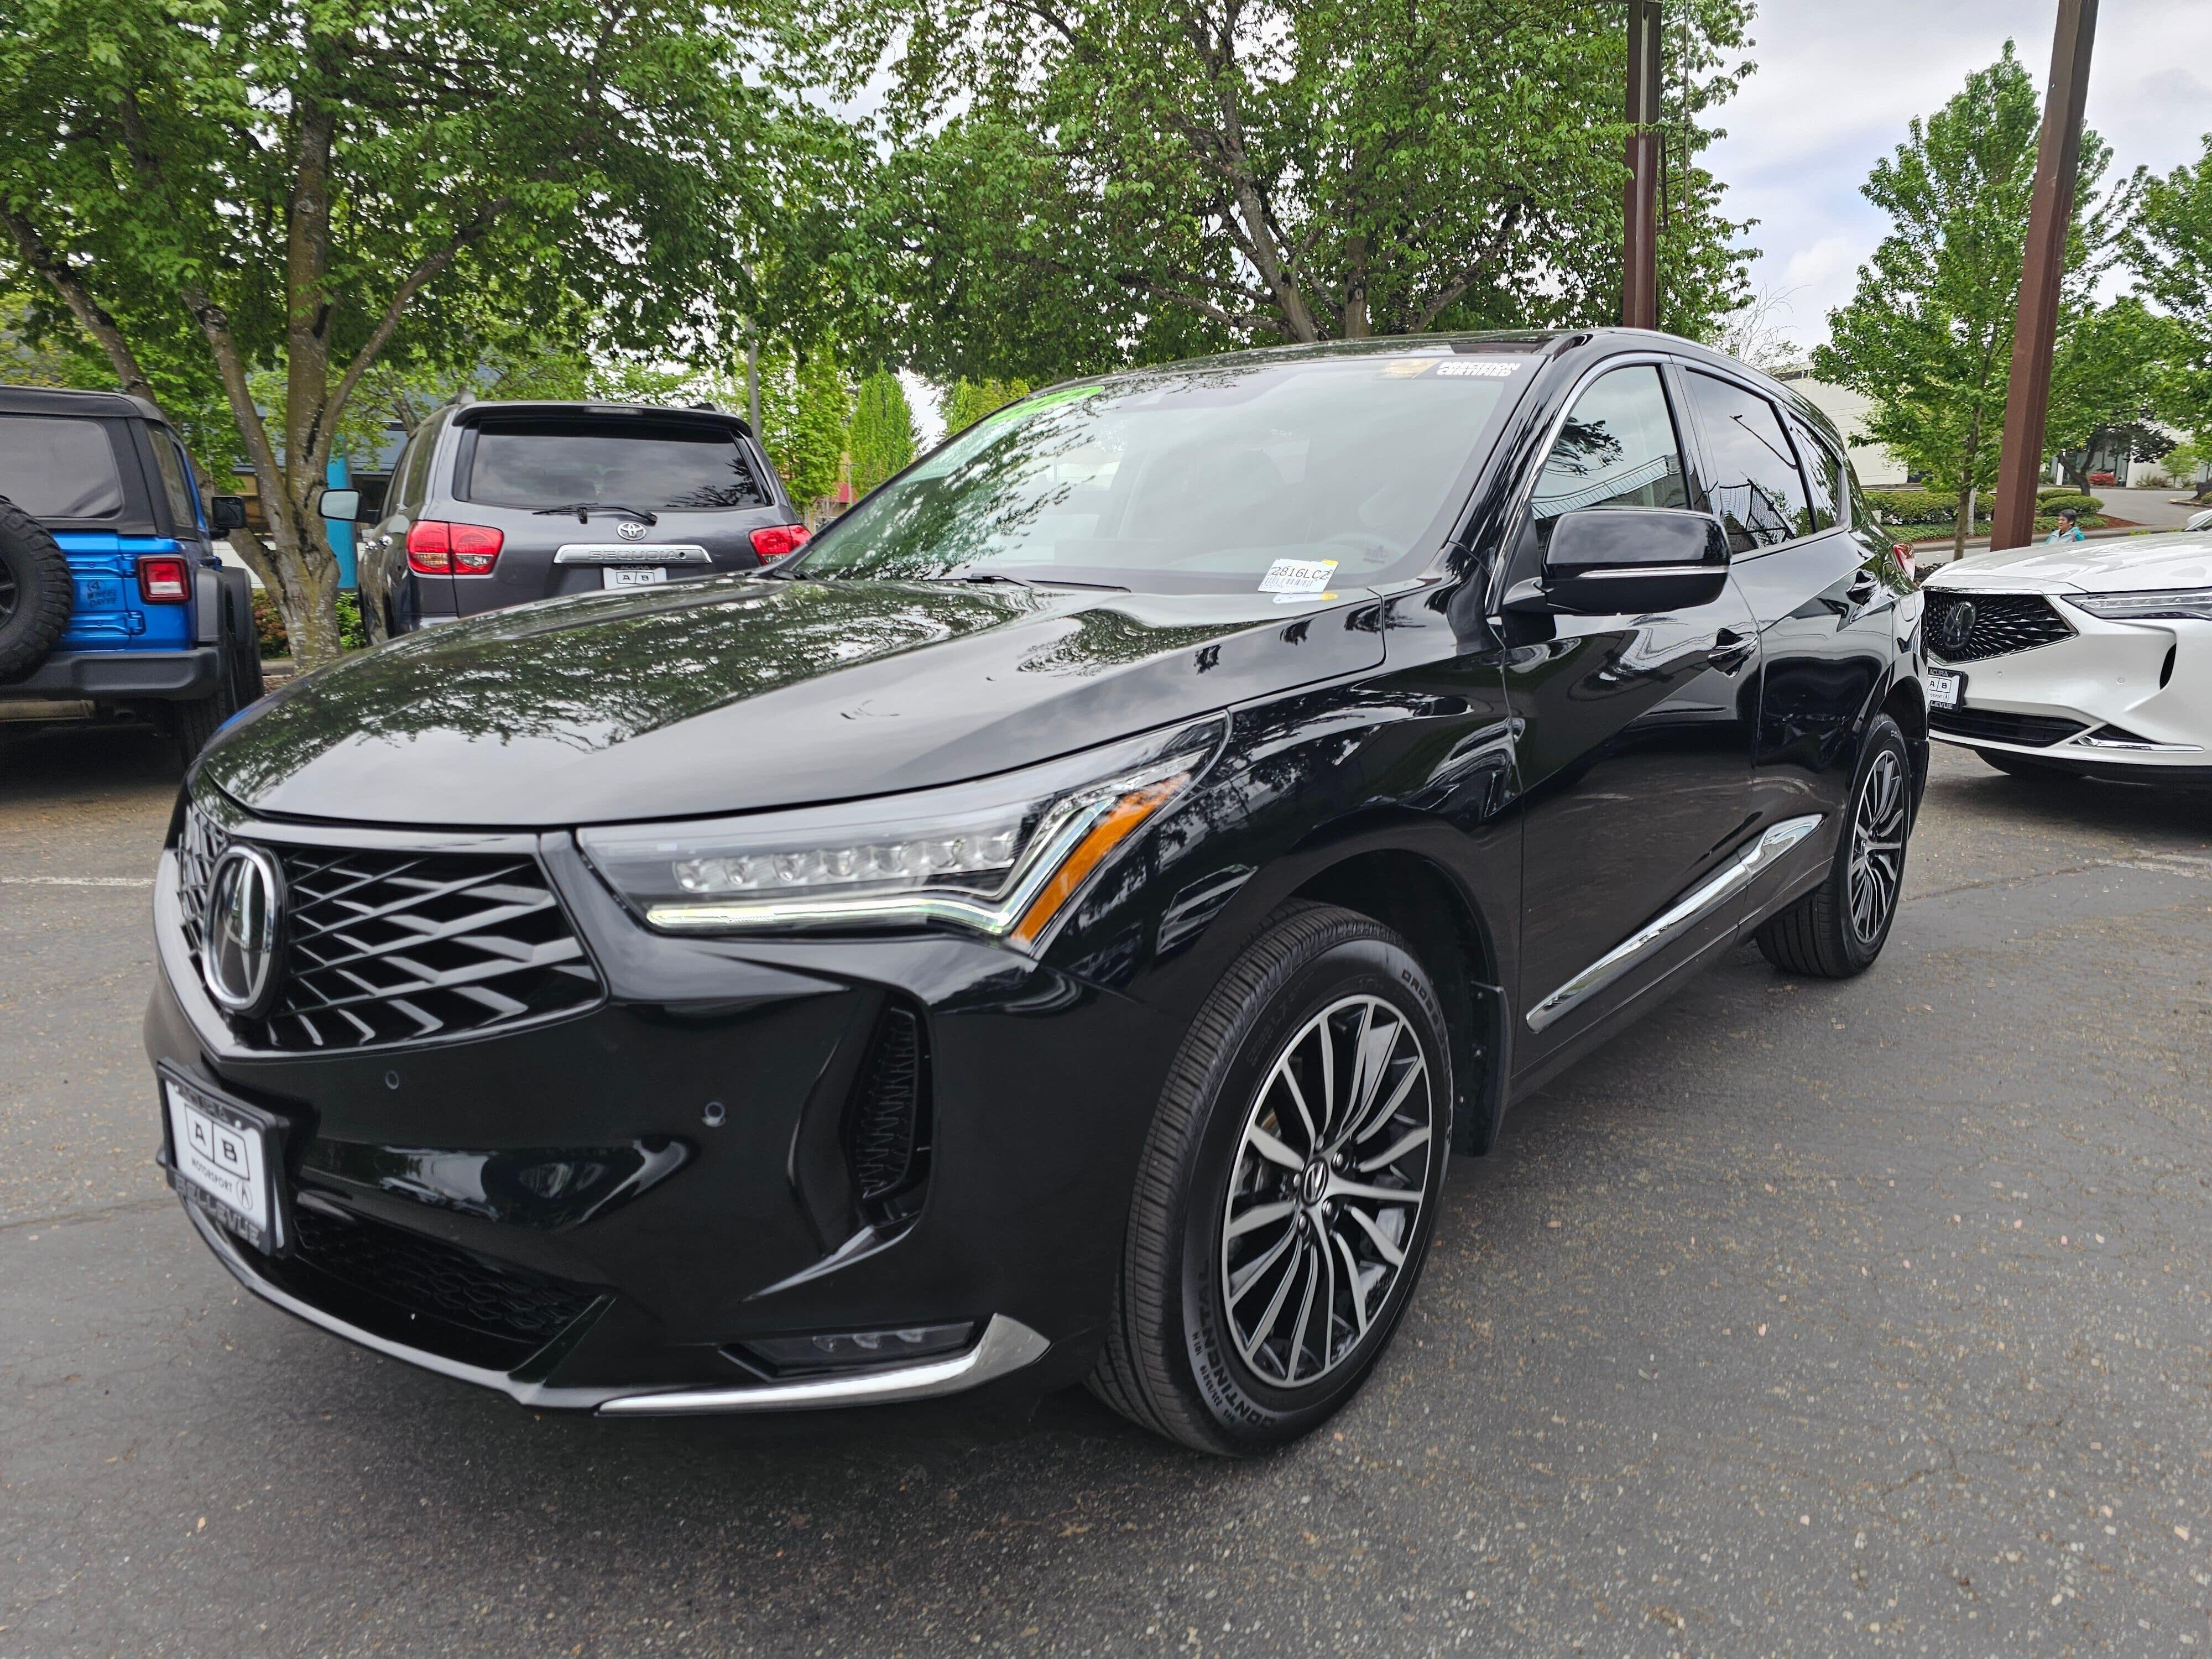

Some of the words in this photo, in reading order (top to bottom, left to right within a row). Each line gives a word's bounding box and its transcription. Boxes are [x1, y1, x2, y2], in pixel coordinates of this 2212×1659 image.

[588, 551, 679, 560] SEQUOIA
[1931, 701, 1953, 709] LEVUE
[195, 1123, 206, 1146] A
[222, 1139, 238, 1165] B
[1198, 1259, 1277, 1429] CONTINENTAL
